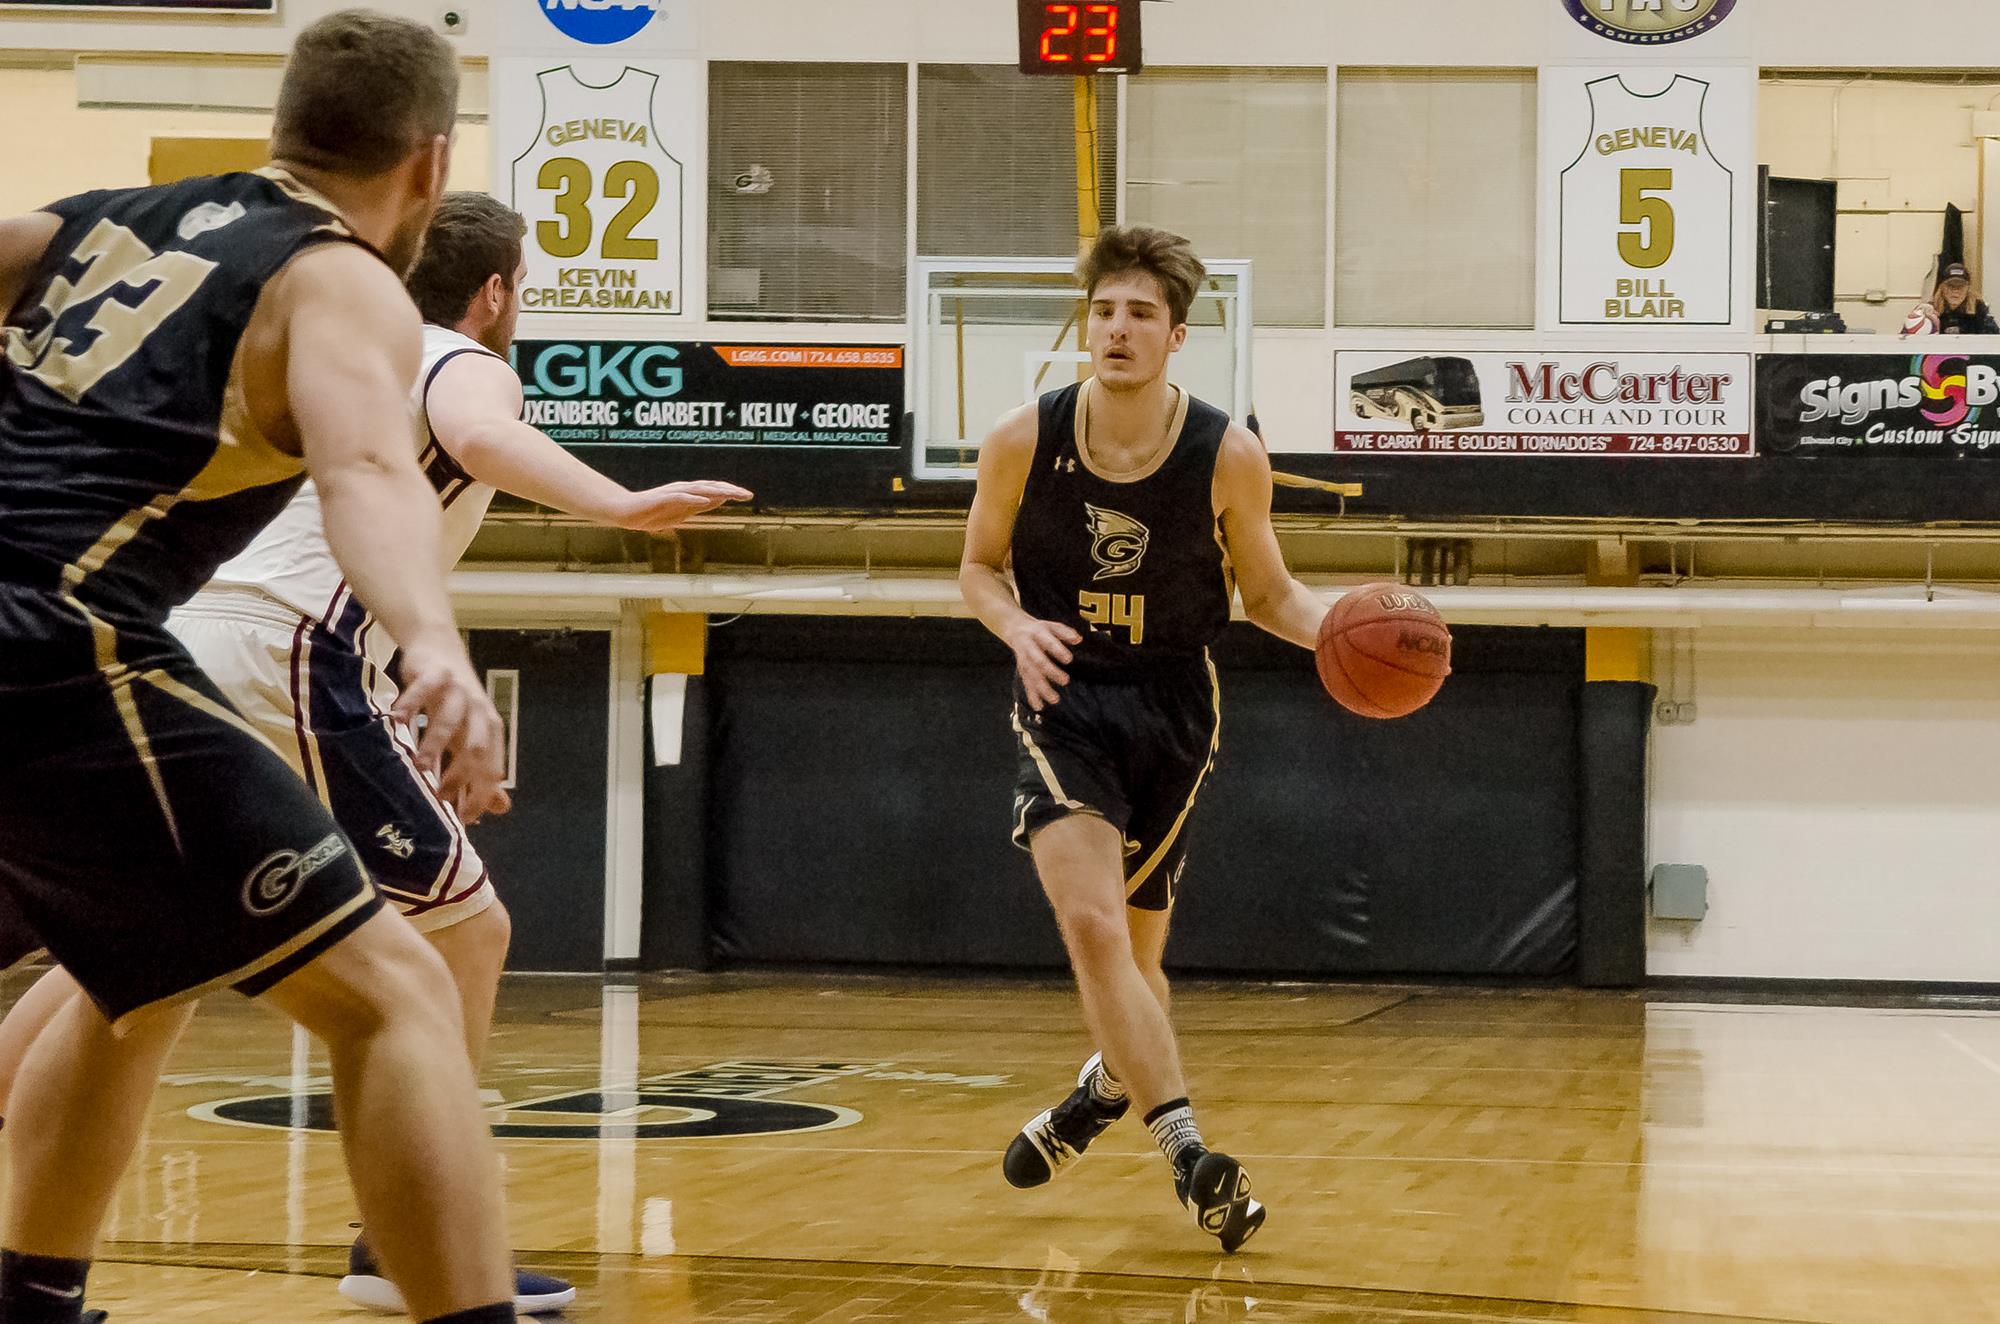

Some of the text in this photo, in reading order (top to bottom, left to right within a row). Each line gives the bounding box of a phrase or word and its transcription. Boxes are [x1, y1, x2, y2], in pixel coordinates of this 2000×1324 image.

[1040, 4, 1118, 62] 23
[1594, 22, 1705, 42] CONFERENCE
[546, 118, 649, 147] GENEVA
[1595, 127, 1698, 156] GENEVA
[536, 157, 660, 260] 32
[1617, 168, 1675, 269] 5
[558, 268, 637, 288] KEVIN
[1616, 278, 1675, 298] BILL
[521, 288, 673, 310] CREASMAN
[1604, 299, 1685, 319] BLAIR
[1504, 361, 1733, 405] McCarter
[1799, 364, 2000, 425] Signs B
[634, 401, 726, 427] GARBETT
[740, 402, 798, 428] KELLY
[811, 402, 891, 429] GEORGE
[1507, 408, 1728, 426] COACH AND TOUR
[546, 429, 600, 440] CCIDENTS
[763, 431, 811, 442] MEDICAL
[813, 432, 890, 443] MALPRACTICE
[1377, 434, 1425, 449] CARRY
[1427, 435, 1455, 449] THE
[1458, 435, 1517, 450] GOLDEN
[1627, 436, 1740, 452] 724-847-0530
[1865, 422, 1943, 445] Custom
[1078, 590, 1145, 645] 24
